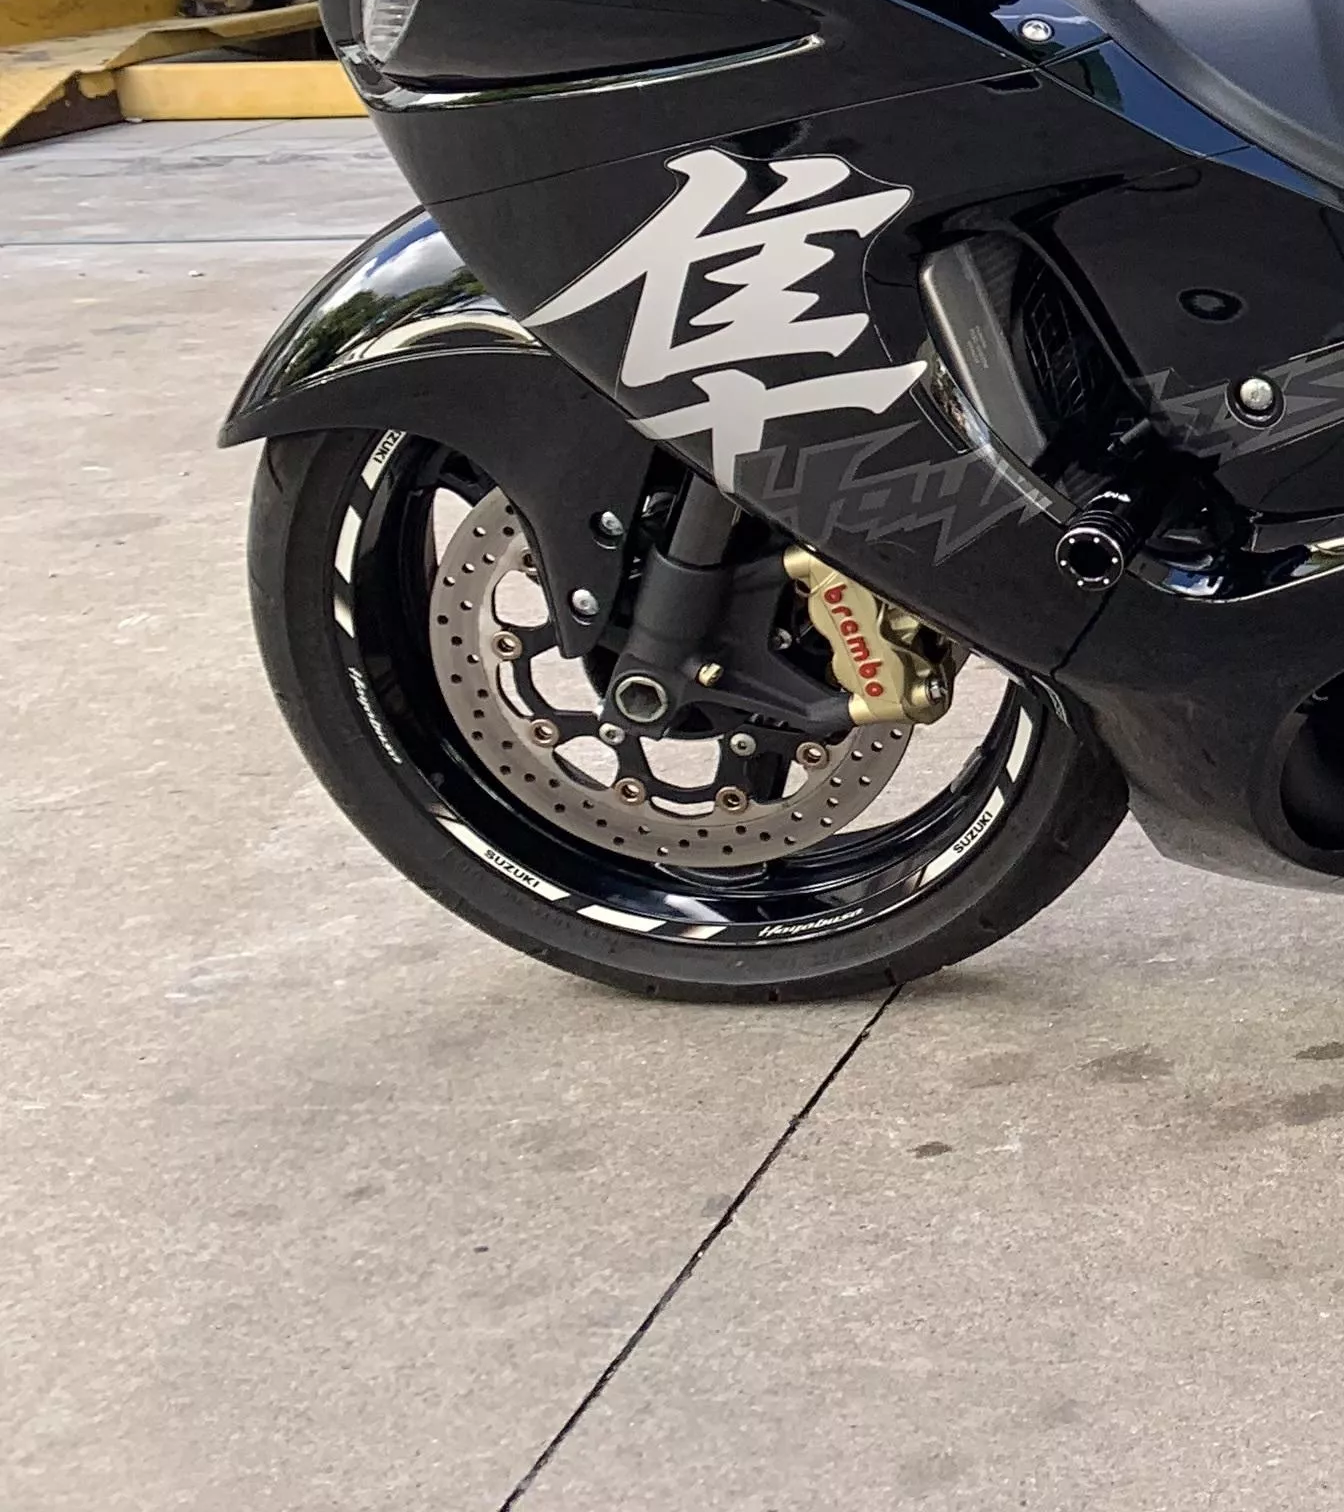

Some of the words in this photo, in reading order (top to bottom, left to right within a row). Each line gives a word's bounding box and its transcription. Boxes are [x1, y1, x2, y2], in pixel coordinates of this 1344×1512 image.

[518, 148, 929, 495] 隼
[373, 430, 402, 464] ZUKI
[823, 583, 886, 698] brembo
[953, 810, 994, 854] SUZUKI
[484, 849, 540, 889] SUZUKI
